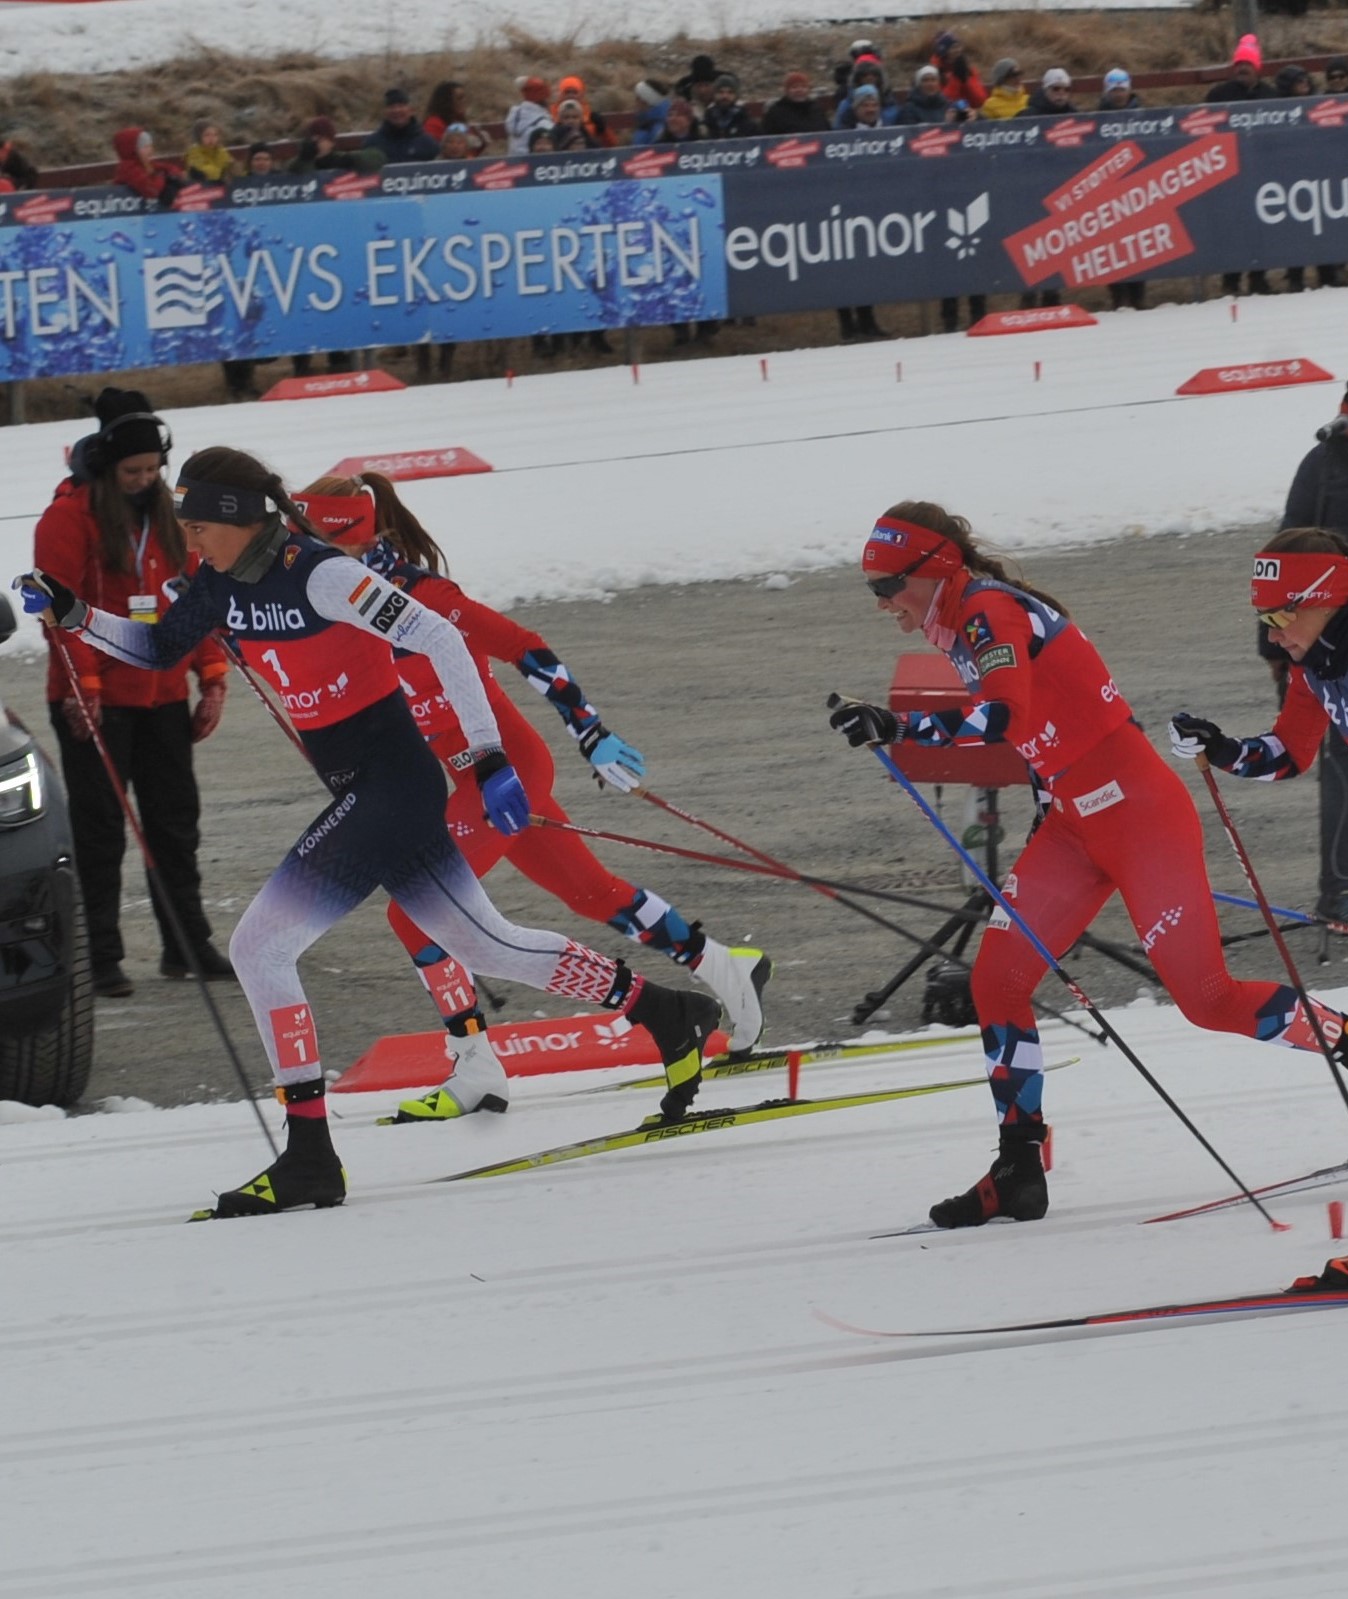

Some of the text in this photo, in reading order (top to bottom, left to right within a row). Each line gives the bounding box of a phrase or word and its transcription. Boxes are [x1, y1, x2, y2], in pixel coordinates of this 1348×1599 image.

[1100, 117, 1161, 138] equinor
[1229, 107, 1289, 129] equinor
[825, 138, 890, 160] equinor
[963, 127, 1026, 150] equinor
[535, 158, 601, 182] equinor
[679, 147, 743, 171] equinor
[382, 170, 448, 194] equinor
[1072, 147, 1134, 202] STØTTER
[74, 194, 143, 217] equinor
[232, 182, 297, 206] equinor
[1022, 145, 1227, 268] MORGENDAGENS
[725, 204, 936, 282] equinor
[1072, 222, 1174, 284] HELTER
[218, 244, 343, 320] VVS
[367, 217, 700, 307] EKSPERTEN
[1217, 364, 1285, 385] equinor
[250, 602, 306, 632] bilia
[261, 648, 290, 688] 1
[281, 686, 322, 710] inor
[1079, 788, 1118, 812] Scandic
[296, 792, 357, 858] KONNERUD
[442, 986, 470, 1013] 11
[293, 1038, 307, 1063] 1
[491, 1030, 582, 1058] uinor
[643, 1115, 737, 1143] FISCHER
